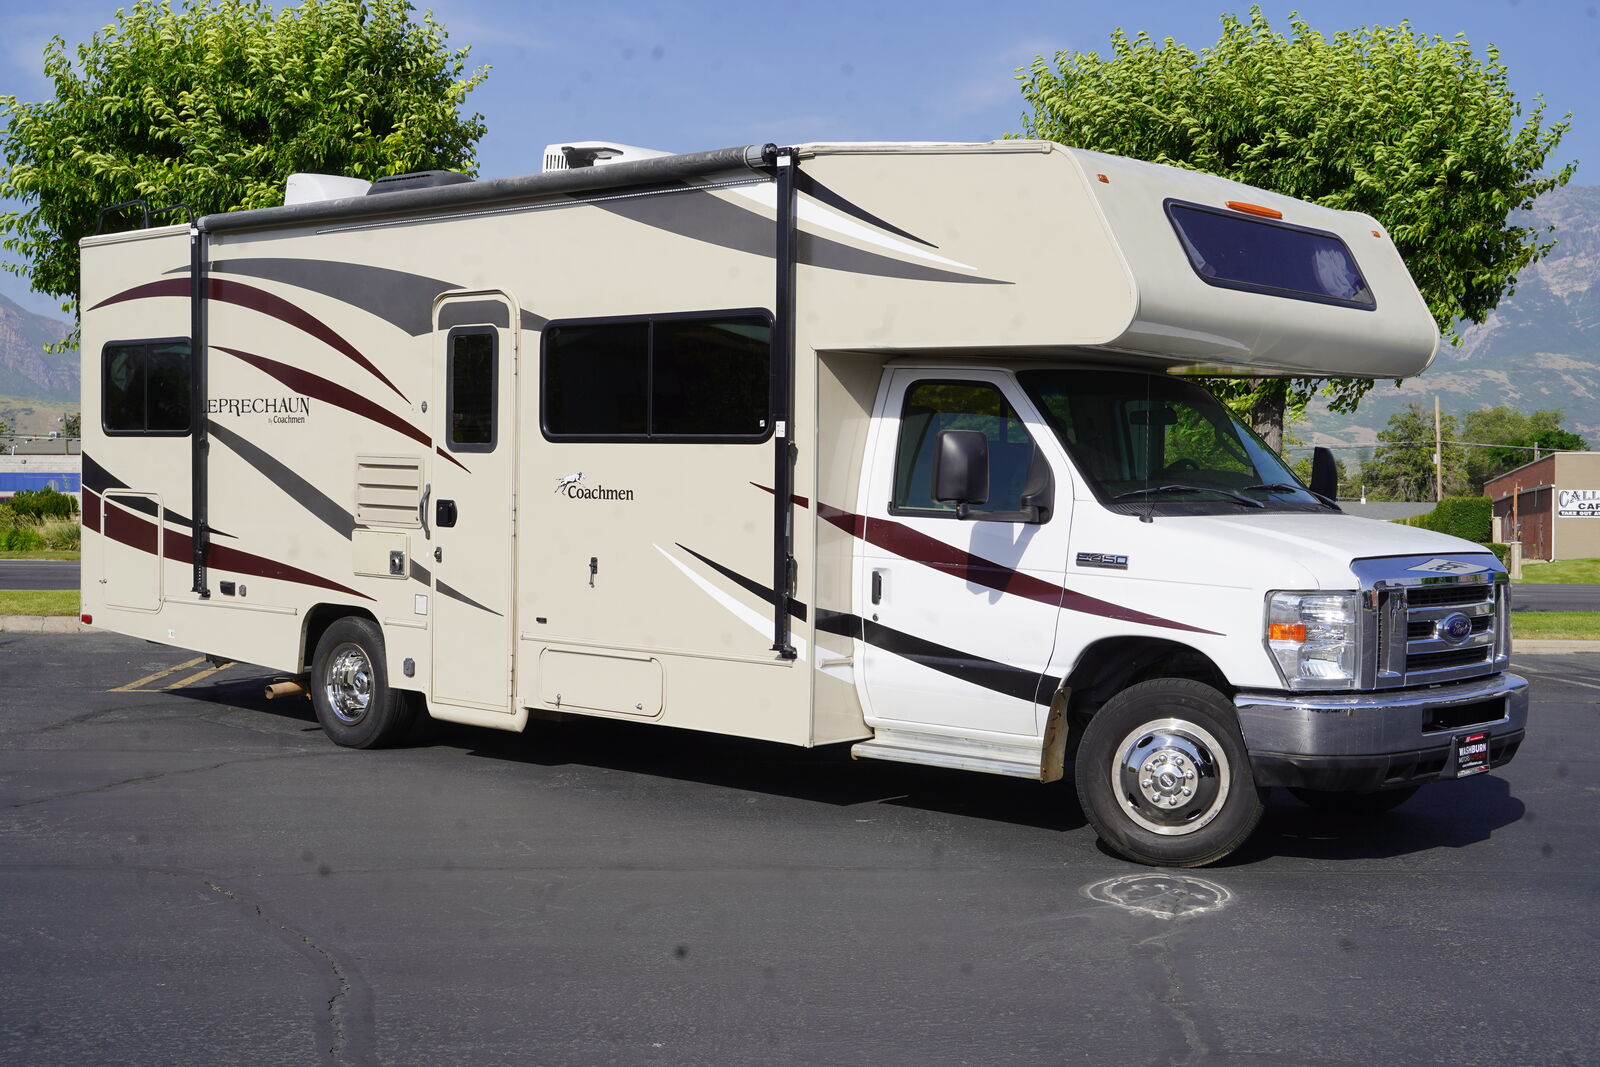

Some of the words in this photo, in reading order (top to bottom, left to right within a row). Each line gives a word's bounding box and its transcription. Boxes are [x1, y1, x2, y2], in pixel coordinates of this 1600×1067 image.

[204, 397, 310, 417] EPRECHAUN
[273, 415, 305, 424] Coachmen
[567, 484, 634, 501] Coachmen
[1458, 743, 1487, 757] WASHBURN
